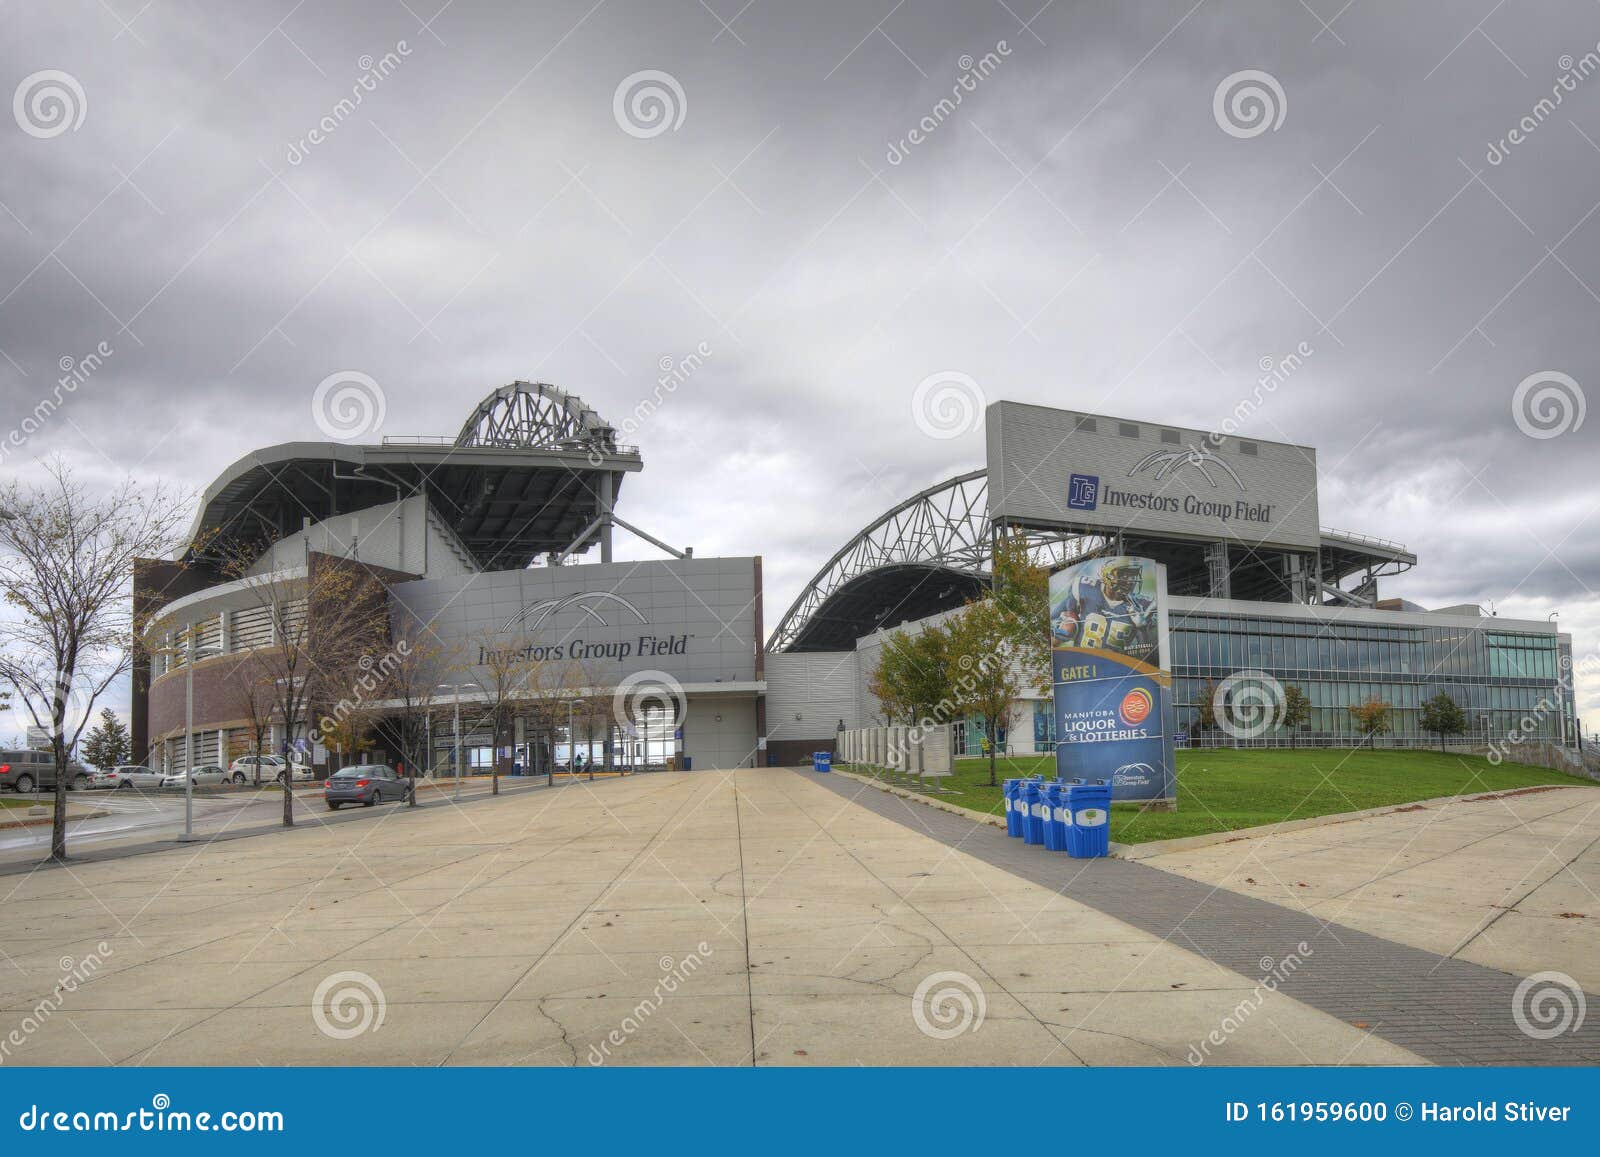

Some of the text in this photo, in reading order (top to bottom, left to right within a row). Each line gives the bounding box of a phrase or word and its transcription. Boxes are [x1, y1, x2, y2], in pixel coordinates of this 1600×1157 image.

[1102, 486, 1179, 513] Investors
[1184, 495, 1232, 522] Group
[477, 645, 564, 665] Investors
[569, 639, 631, 662] Group
[1061, 665, 1090, 681] GATE
[1064, 709, 1115, 720] MANITOBA
[1064, 719, 1116, 733] LIQUOR
[1069, 728, 1148, 743] & LOTTERIES
